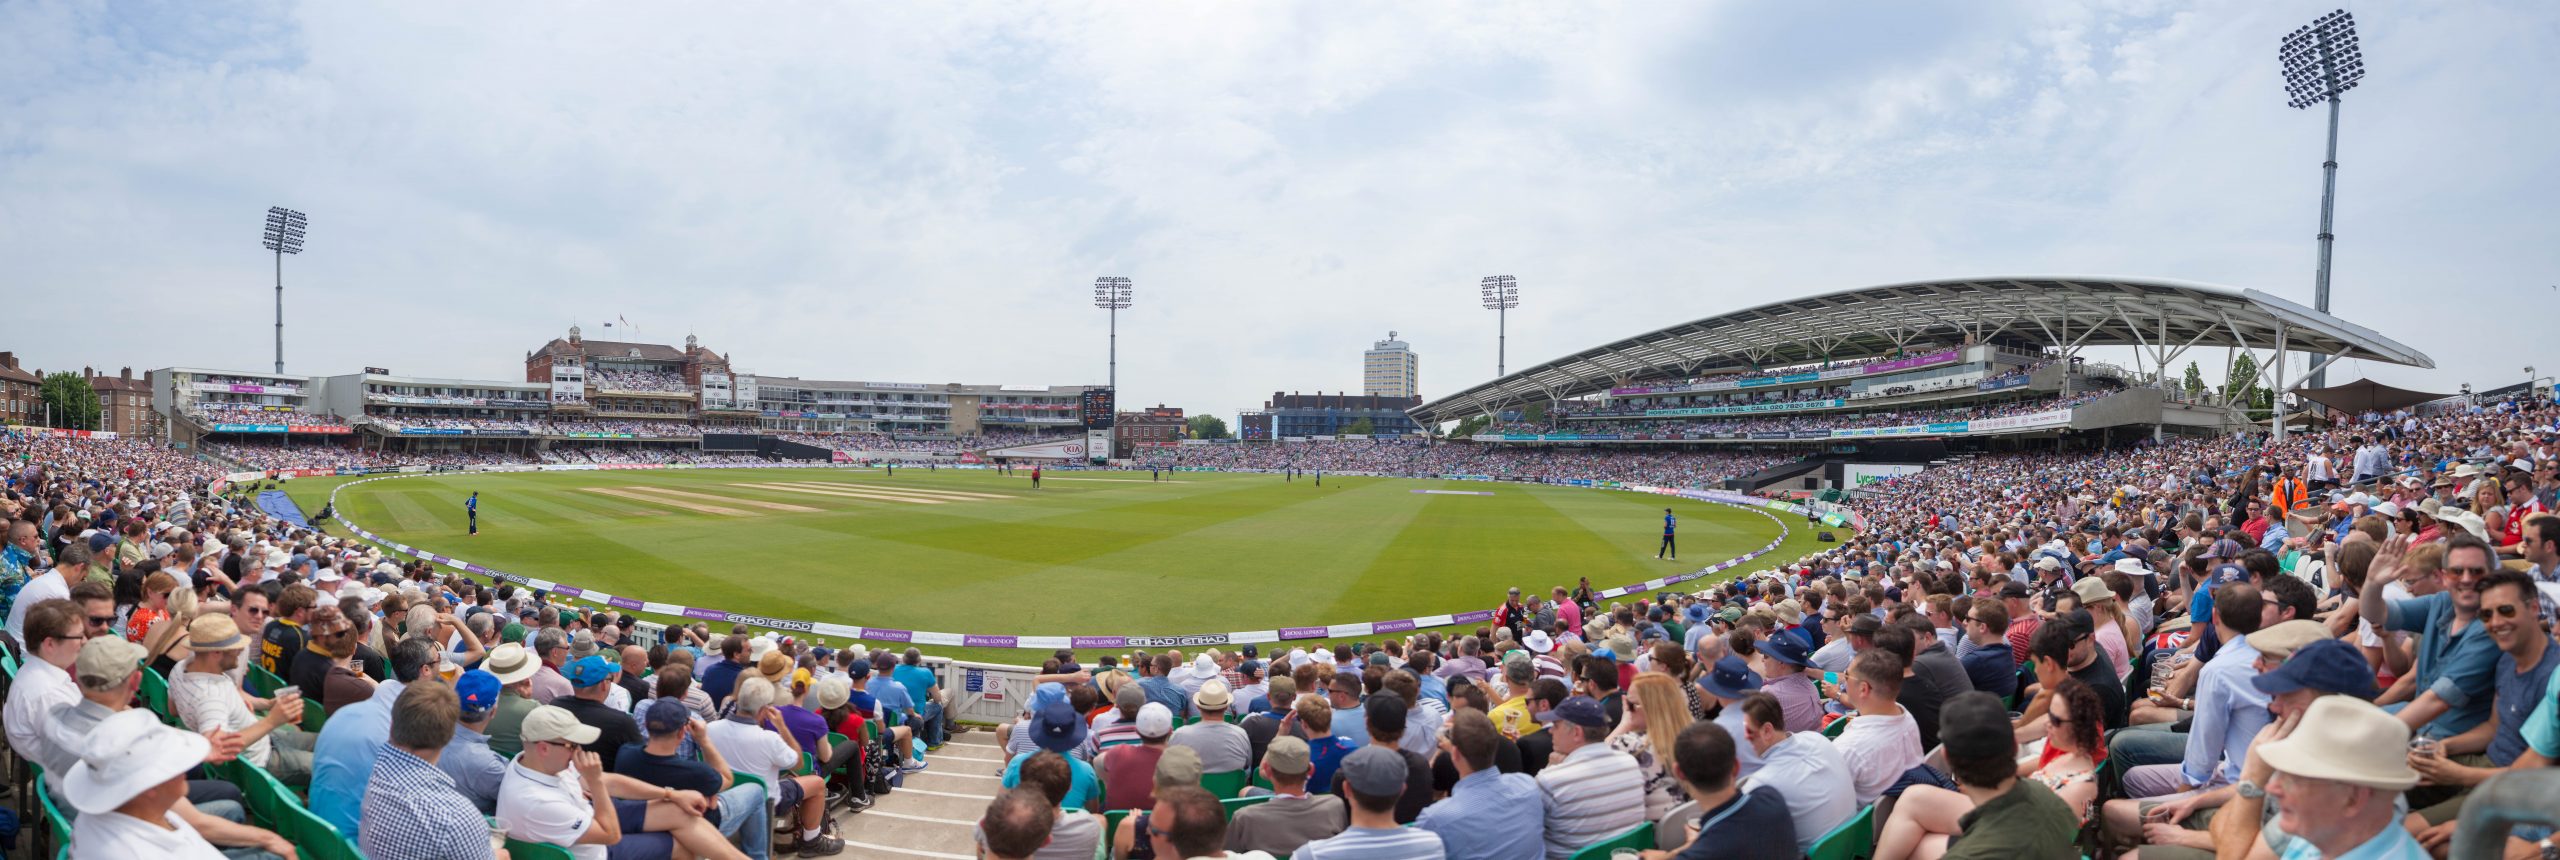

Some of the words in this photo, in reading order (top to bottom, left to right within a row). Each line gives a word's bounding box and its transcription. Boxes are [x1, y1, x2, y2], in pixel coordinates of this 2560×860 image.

[728, 614, 766, 625] ETIHAD
[769, 620, 810, 630] ETIHAD
[1128, 637, 1175, 646] ETIHAD
[1182, 635, 1226, 644] ETIHAD
